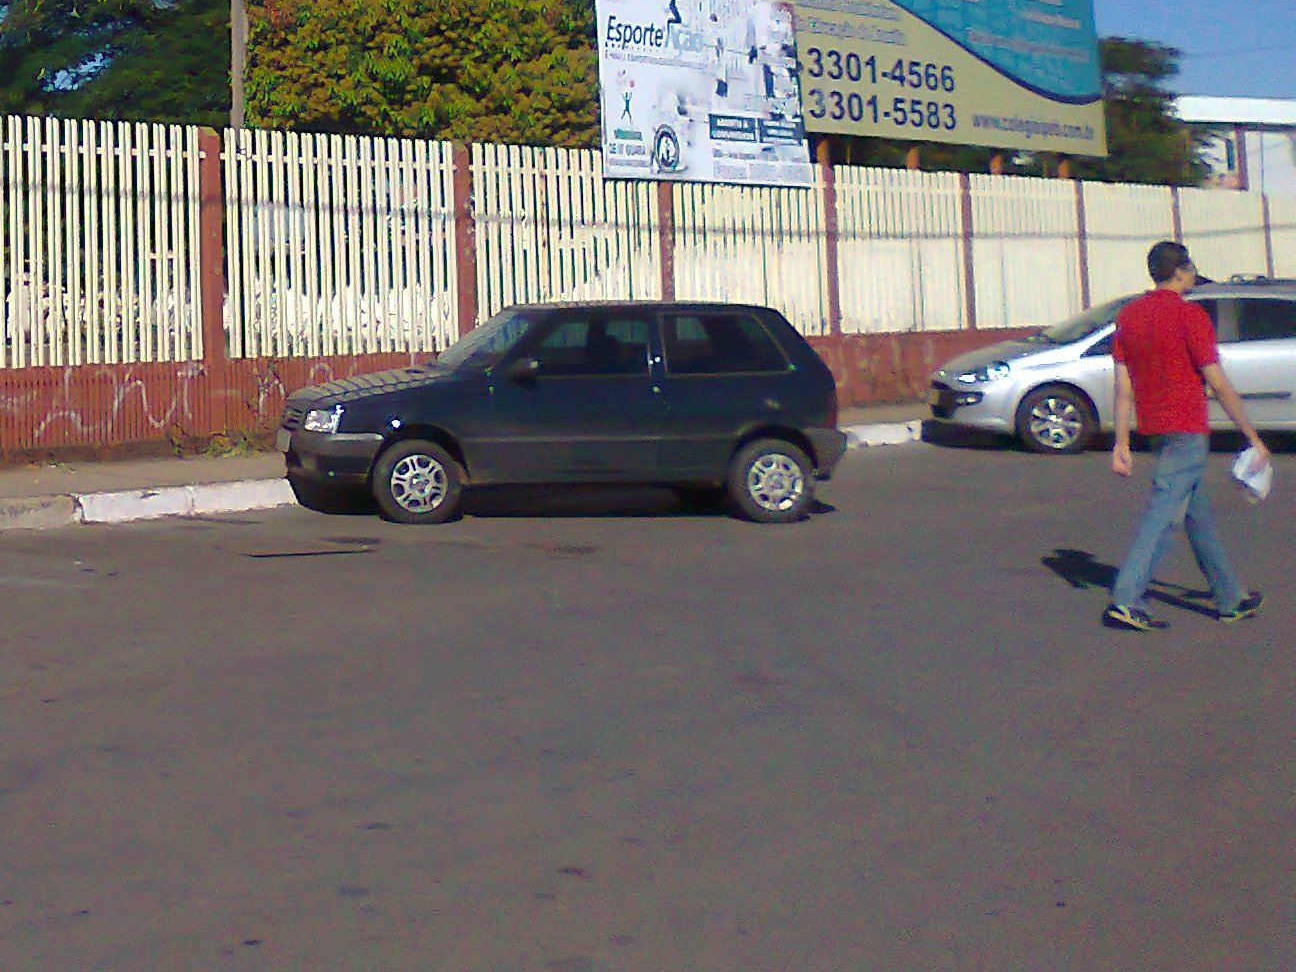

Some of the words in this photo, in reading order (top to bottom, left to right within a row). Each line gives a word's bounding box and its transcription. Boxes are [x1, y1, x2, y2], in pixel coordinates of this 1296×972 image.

[606, 15, 664, 50] Esporte
[807, 47, 955, 93] 3301-4566
[808, 87, 957, 131] 3301-5583
